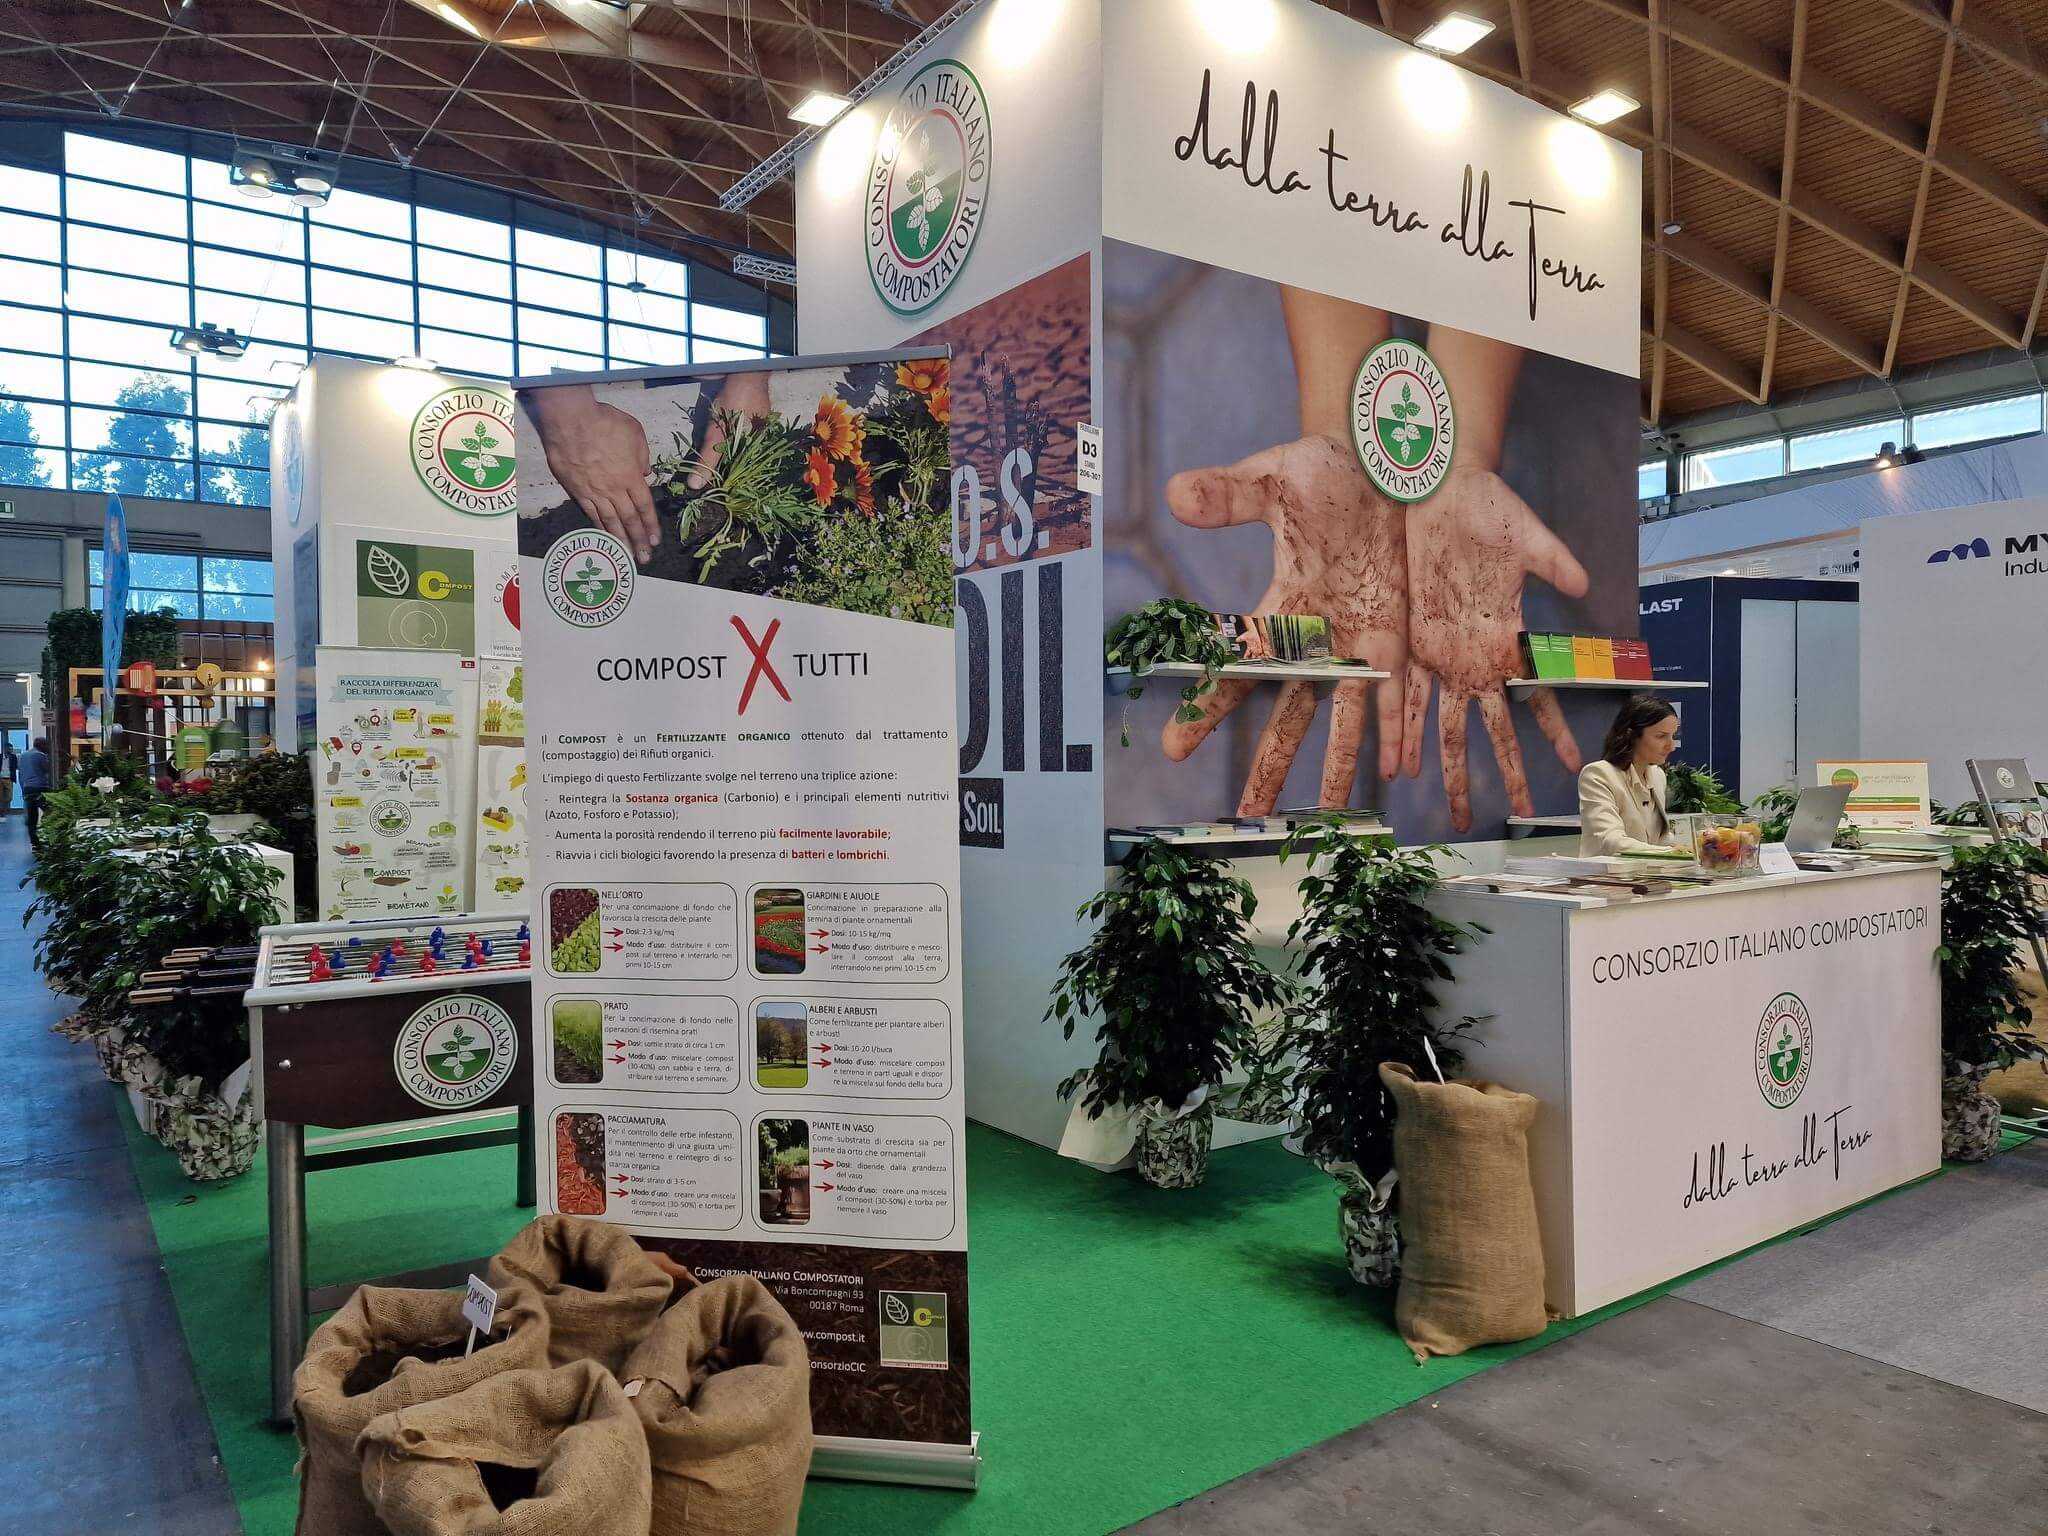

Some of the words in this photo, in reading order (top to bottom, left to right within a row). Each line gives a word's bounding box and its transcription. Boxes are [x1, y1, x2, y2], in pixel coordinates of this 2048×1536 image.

[936, 74, 985, 183] ITALIANO
[1174, 68, 1311, 194] dalla
[1318, 128, 1428, 232] terra
[1441, 163, 1514, 261] alla
[1508, 198, 1605, 320] Terra
[876, 196, 980, 302] COMPOSTATORI
[1358, 348, 1409, 432] CONSORZIO
[1415, 355, 1450, 445] ITALIANO
[418, 394, 483, 460] CONSORZIO
[1083, 440, 1097, 458] D3
[1362, 440, 1448, 494] COMPOSTATORI
[548, 536, 590, 592] CONSORZIO
[596, 538, 630, 588] ITALIANO
[494, 564, 518, 603] COMP
[553, 591, 628, 623] COMPOSTATORI
[598, 656, 727, 681] COMPOST
[730, 615, 792, 716] X
[793, 652, 867, 676] TUTTI
[542, 735, 546, 744] Il
[558, 735, 606, 744] COMPOST
[657, 733, 726, 742] FERTILIZZANTE
[738, 733, 790, 741] ORGANICO
[801, 731, 844, 740] ottenuto
[856, 730, 871, 740] dal
[884, 730, 948, 739] trattamento
[542, 749, 620, 762] (compostaggio)
[623, 749, 638, 759] dei
[640, 749, 668, 758] Rifiuti
[672, 749, 714, 760] organici.
[543, 773, 592, 784] L'impiego
[594, 773, 604, 782] di
[606, 774, 640, 784] questo
[643, 772, 702, 782] Fertilizzante
[705, 772, 737, 783] svolge
[741, 771, 756, 780] nel
[760, 772, 798, 780] terreno
[822, 770, 856, 782] triplice
[860, 770, 896, 780] azione:
[560, 795, 607, 806] Reintegra
[612, 794, 620, 803] la
[626, 794, 669, 803] Sostanza
[674, 793, 718, 805] organica
[724, 792, 778, 804] (Carbonio)
[804, 792, 848, 804] principali
[854, 792, 901, 802] elementi
[907, 792, 949, 801] nutritivi
[545, 810, 580, 822] (Azoto,
[584, 809, 620, 819] Fosforo
[632, 809, 678, 820] Potassio);
[555, 830, 601, 840] Aumenta
[604, 829, 612, 839] la
[616, 829, 654, 841] porosità
[658, 829, 706, 840] rendendo
[710, 830, 714, 839] il
[718, 830, 757, 839] terreno
[760, 828, 776, 840] più
[779, 828, 832, 838] facilmente
[836, 829, 890, 840] lavorabile;
[556, 850, 591, 860] Riavvia
[600, 850, 618, 859] cicli
[621, 850, 660, 862] biologici
[664, 850, 715, 860] favorendo
[718, 850, 726, 859] la
[730, 852, 776, 861] presenza
[779, 849, 788, 858] di
[792, 849, 825, 859] batteri
[837, 849, 889, 860] lombrichi.
[602, 891, 643, 899] NELL'ORTO
[850, 892, 879, 900] AIUOLE
[387, 902, 429, 910] BIOMETANO
[1592, 940, 1719, 983] CONSORZIO
[1724, 926, 1805, 962] ITALIANO
[1810, 906, 1928, 946] COMPOSTATORI
[604, 1002, 628, 1010] PRATO
[809, 1005, 835, 1013] ALBERI
[844, 1007, 877, 1015] ARBUSTI
[404, 1002, 460, 1070] CONSORZIO
[468, 1002, 510, 1057] ITALIANO
[1758, 1000, 1786, 1070] CONSORZIO
[1790, 1000, 1810, 1056] ITALIANO
[410, 1061, 506, 1101] COMPOSTATORI
[1762, 1061, 1808, 1103] COMPOSTATORI
[608, 1115, 666, 1126] PACCIAMATURA
[813, 1122, 840, 1131] PIANTE
[853, 1124, 874, 1133] VASO
[1683, 1142, 1738, 1208] dalla
[1742, 1143, 1788, 1186] terra
[1794, 1112, 1827, 1168] alla
[1824, 1105, 1872, 1181] Terra
[793, 1271, 864, 1285] COMPOSTATORI
[775, 1286, 788, 1294] Via
[791, 1286, 850, 1299] Boncompagni
[853, 1291, 864, 1299] 93
[810, 1301, 836, 1310] 00187
[840, 1303, 864, 1312] Roma
[808, 1360, 866, 1372] onsorzioCIC
